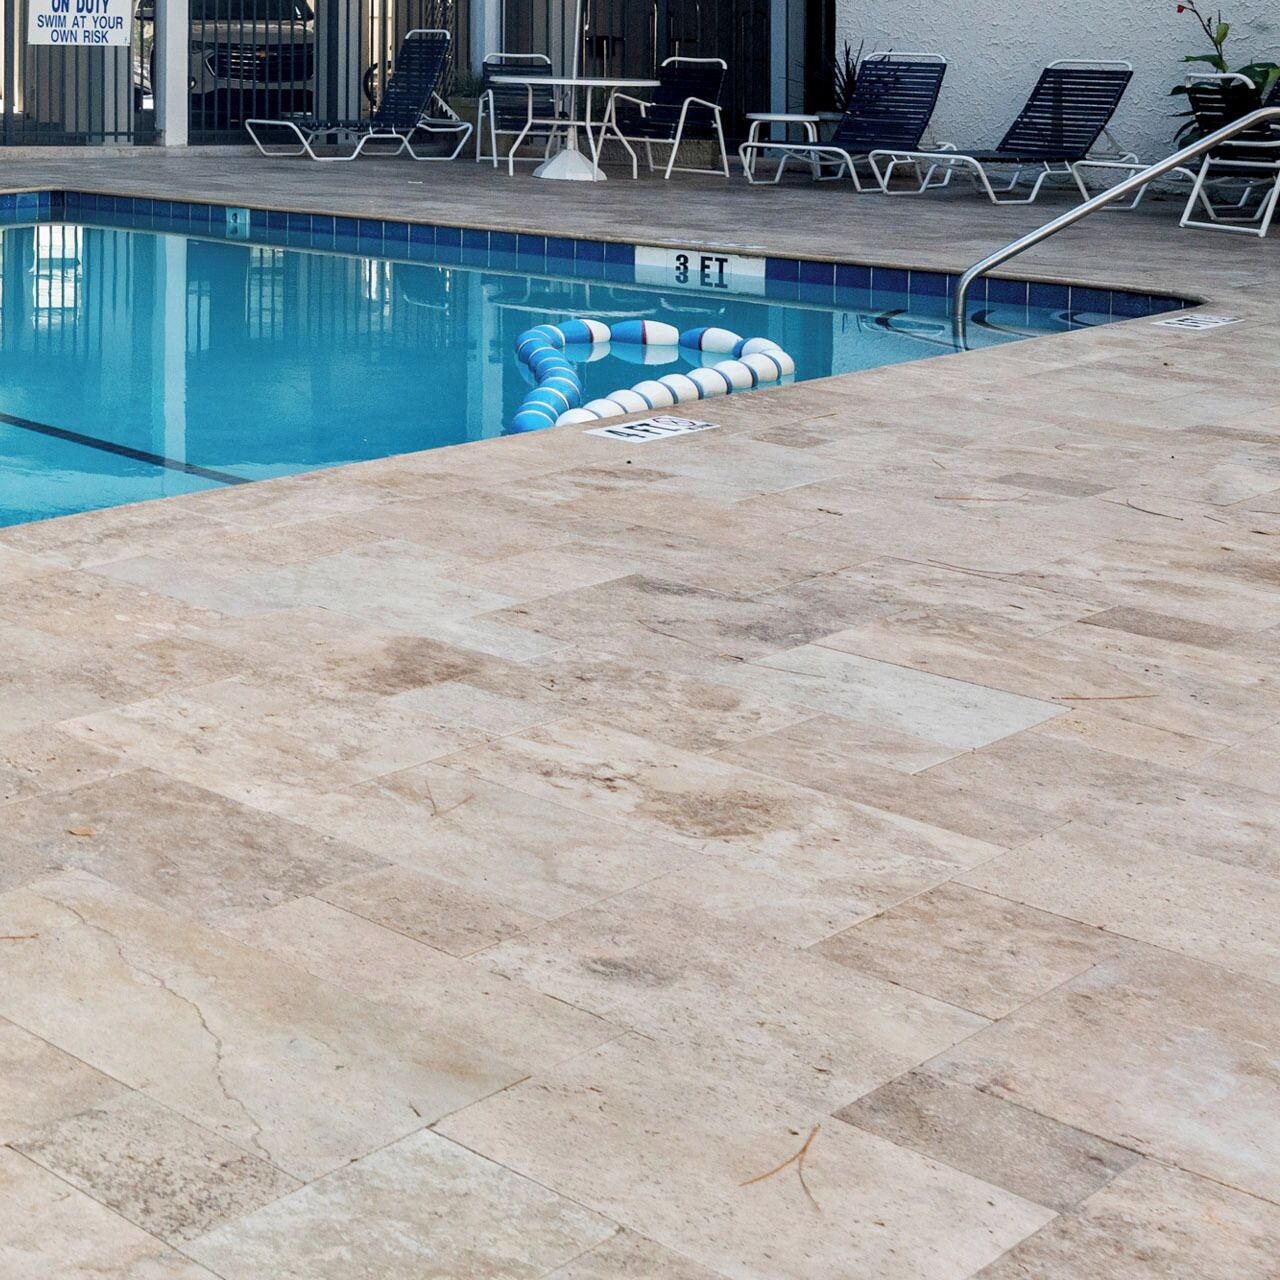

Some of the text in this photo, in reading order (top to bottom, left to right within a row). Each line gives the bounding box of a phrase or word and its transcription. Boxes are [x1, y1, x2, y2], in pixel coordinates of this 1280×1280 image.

[37, 14, 123, 29] SWIM AT YOUR
[51, 29, 109, 44] OWN RISK
